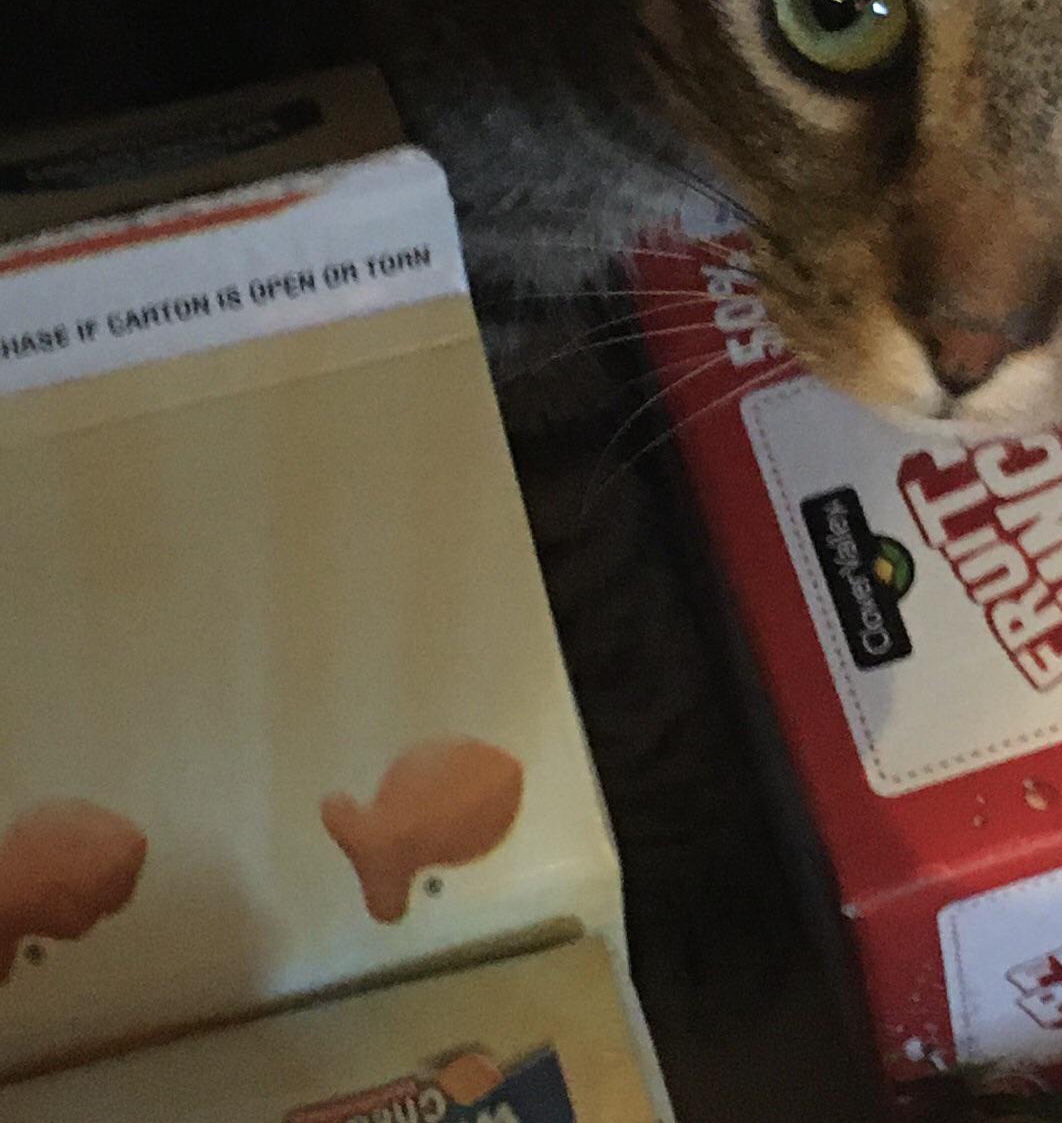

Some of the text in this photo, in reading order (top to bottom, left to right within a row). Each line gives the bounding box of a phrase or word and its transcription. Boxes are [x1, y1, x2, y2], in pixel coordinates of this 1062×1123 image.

[76, 317, 98, 344] IF
[107, 294, 211, 338] CARTON
[216, 283, 243, 311] IS
[249, 268, 316, 307] OPEN
[322, 259, 359, 290] OR
[365, 242, 431, 278] TORN
[848, 571, 893, 656] Clover
